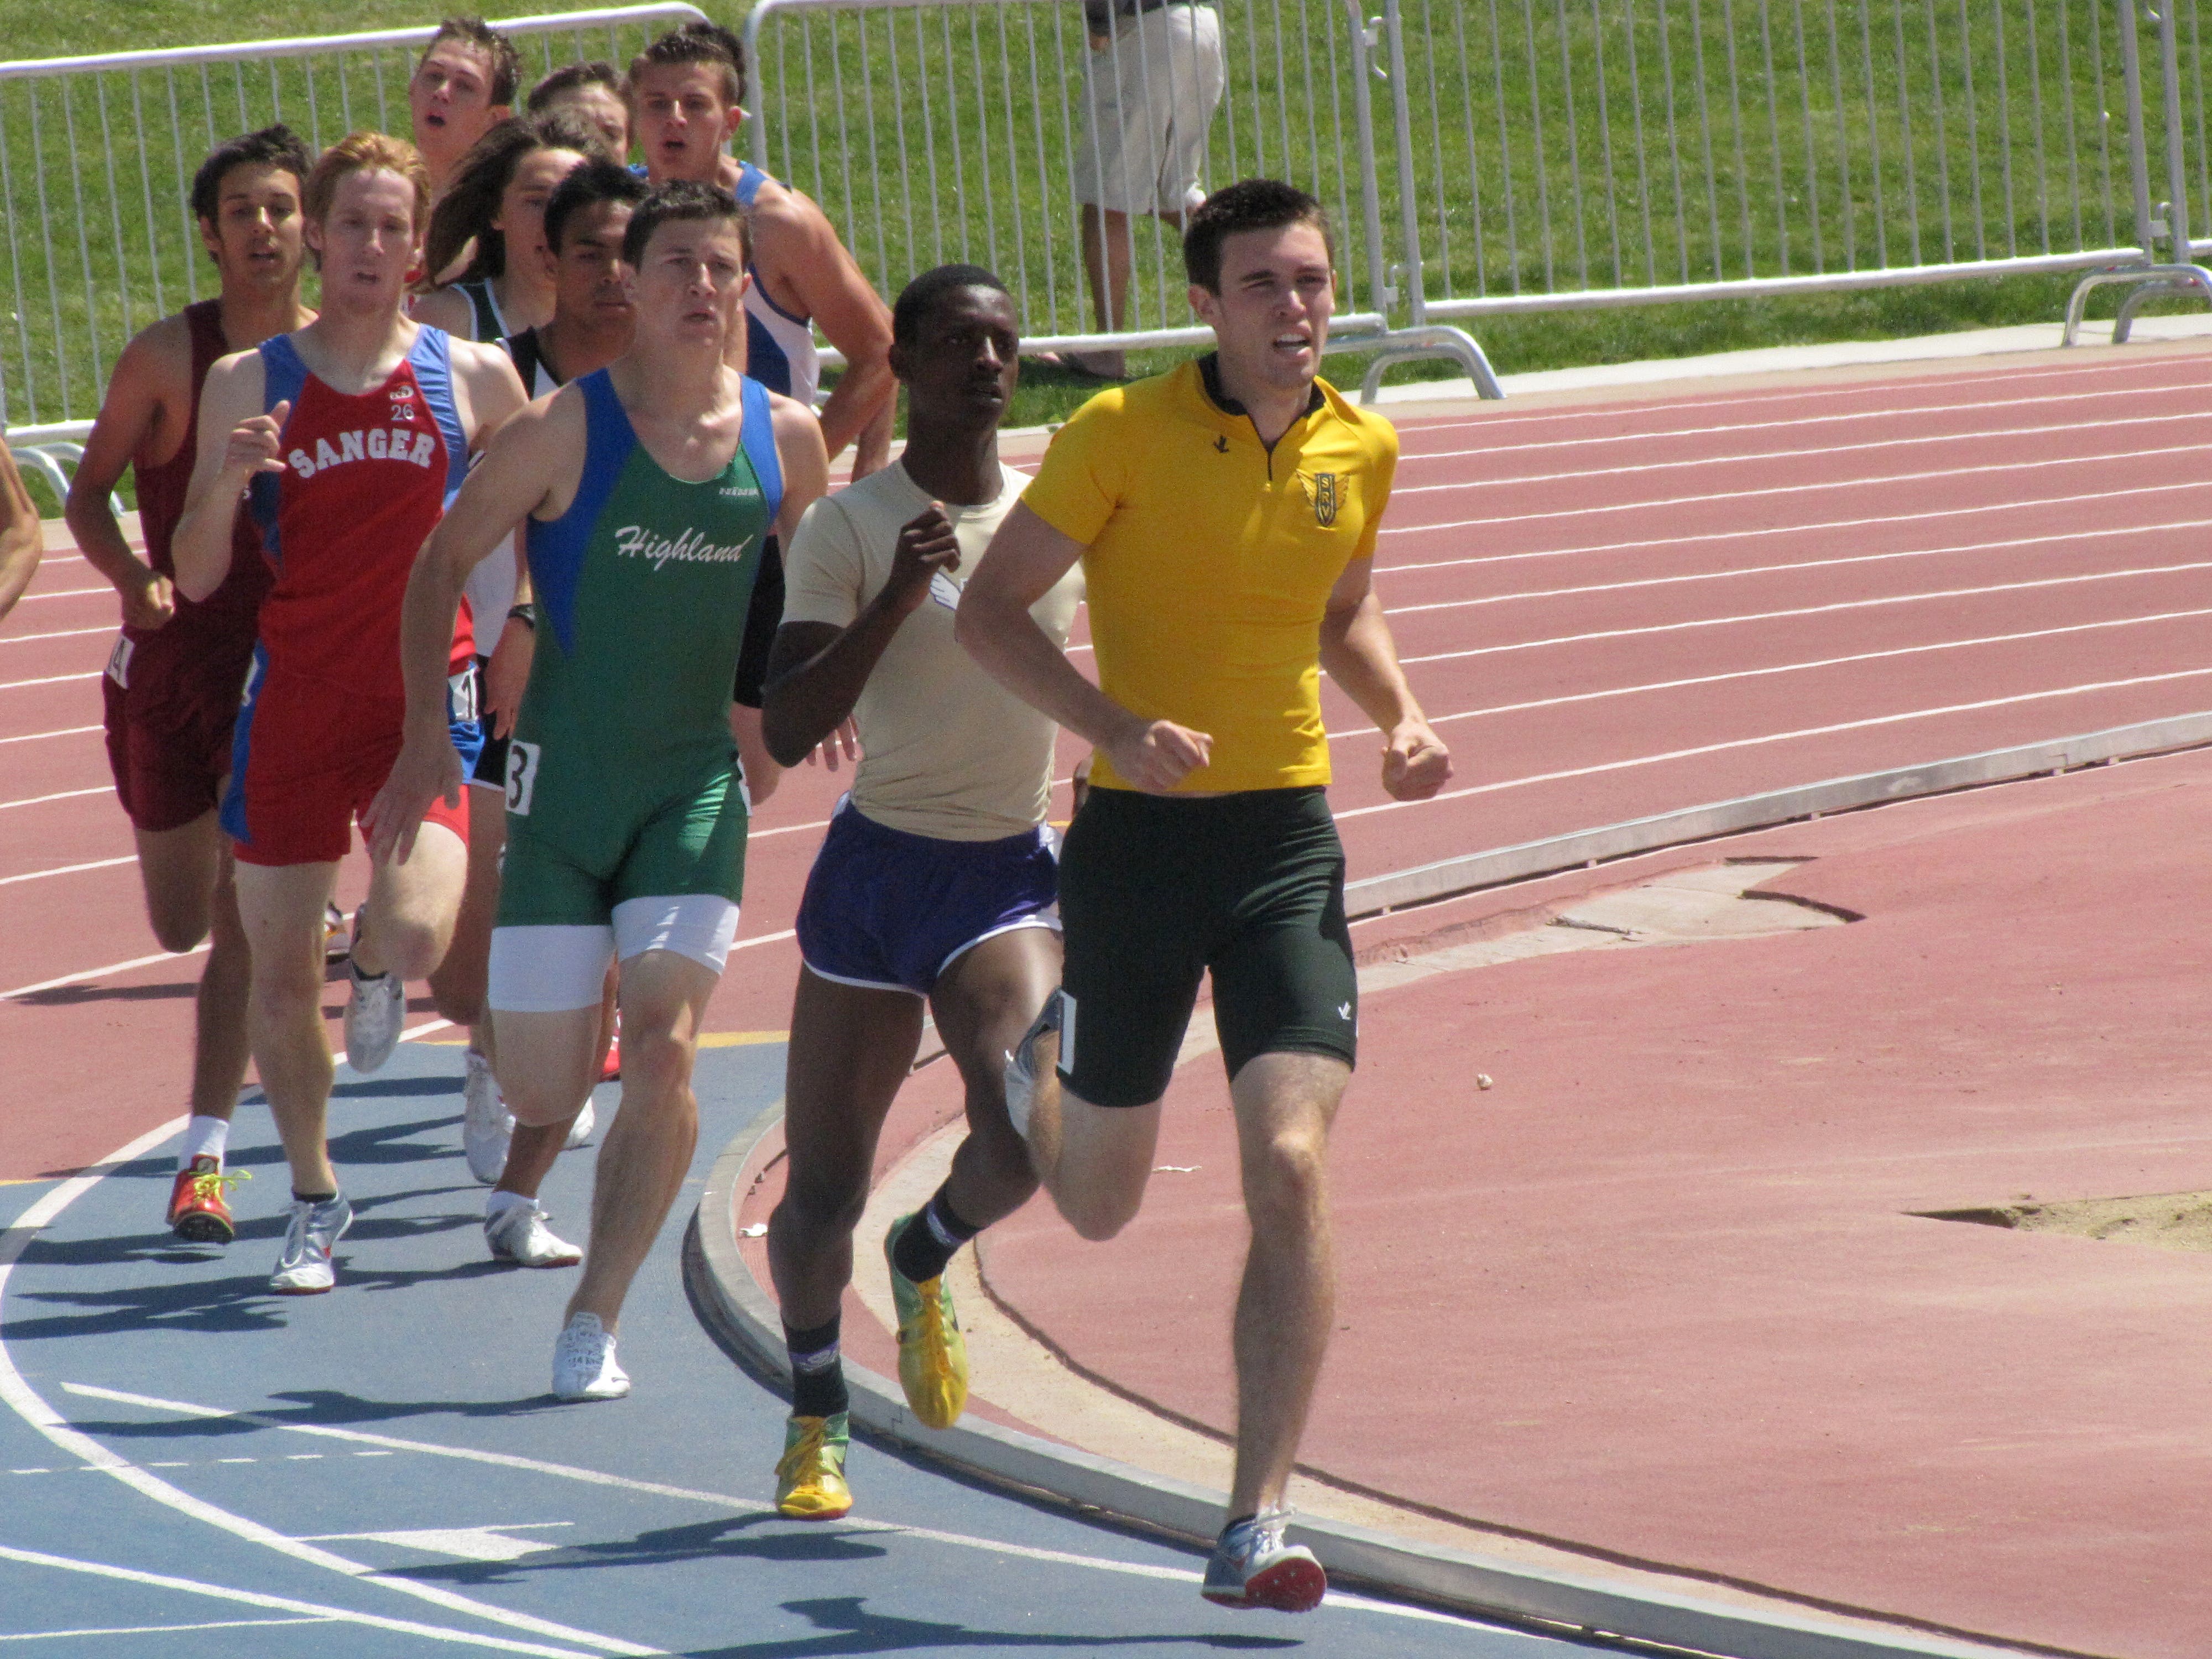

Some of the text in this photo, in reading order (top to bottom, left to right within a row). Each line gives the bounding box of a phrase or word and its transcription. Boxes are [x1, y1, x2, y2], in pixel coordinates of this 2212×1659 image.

[390, 404, 415, 420] 26
[288, 428, 436, 478] SANGER
[615, 525, 754, 571] Highland
[462, 674, 472, 719] 1
[508, 745, 528, 808] 3
